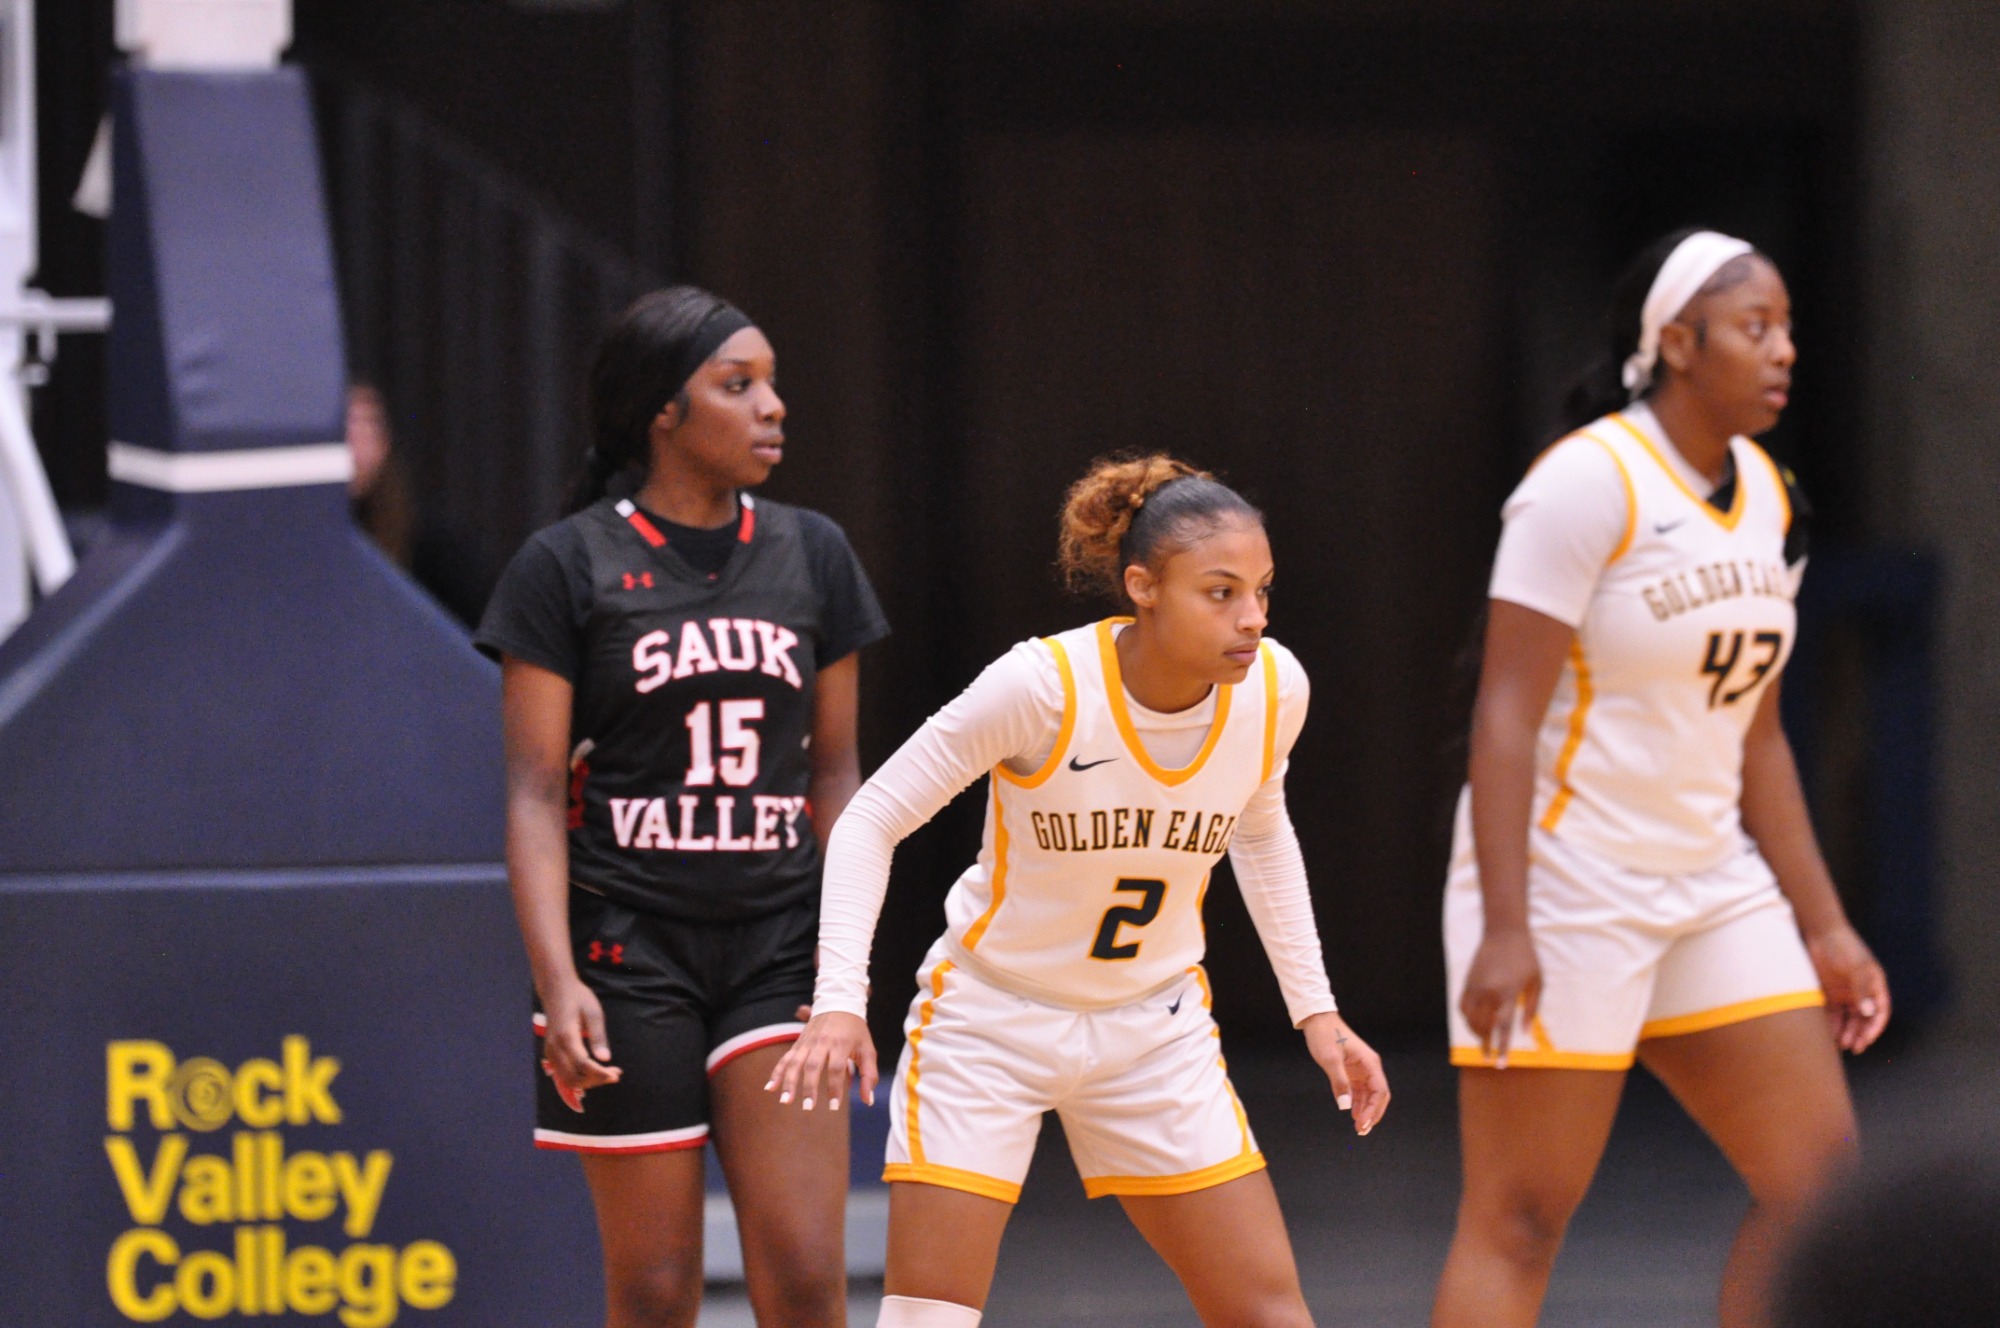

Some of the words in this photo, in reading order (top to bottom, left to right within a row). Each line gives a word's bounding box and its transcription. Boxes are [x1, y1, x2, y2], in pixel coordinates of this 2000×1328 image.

[632, 617, 803, 694] SAUK
[1700, 630, 1783, 711] 43
[684, 699, 765, 788] 15
[609, 794, 806, 852] VALLEY
[1031, 808, 1155, 851] GOLDEN
[1087, 876, 1169, 962] 2
[105, 1033, 342, 1132] Rock
[104, 1130, 394, 1238] Valley
[106, 1225, 458, 1328] College
